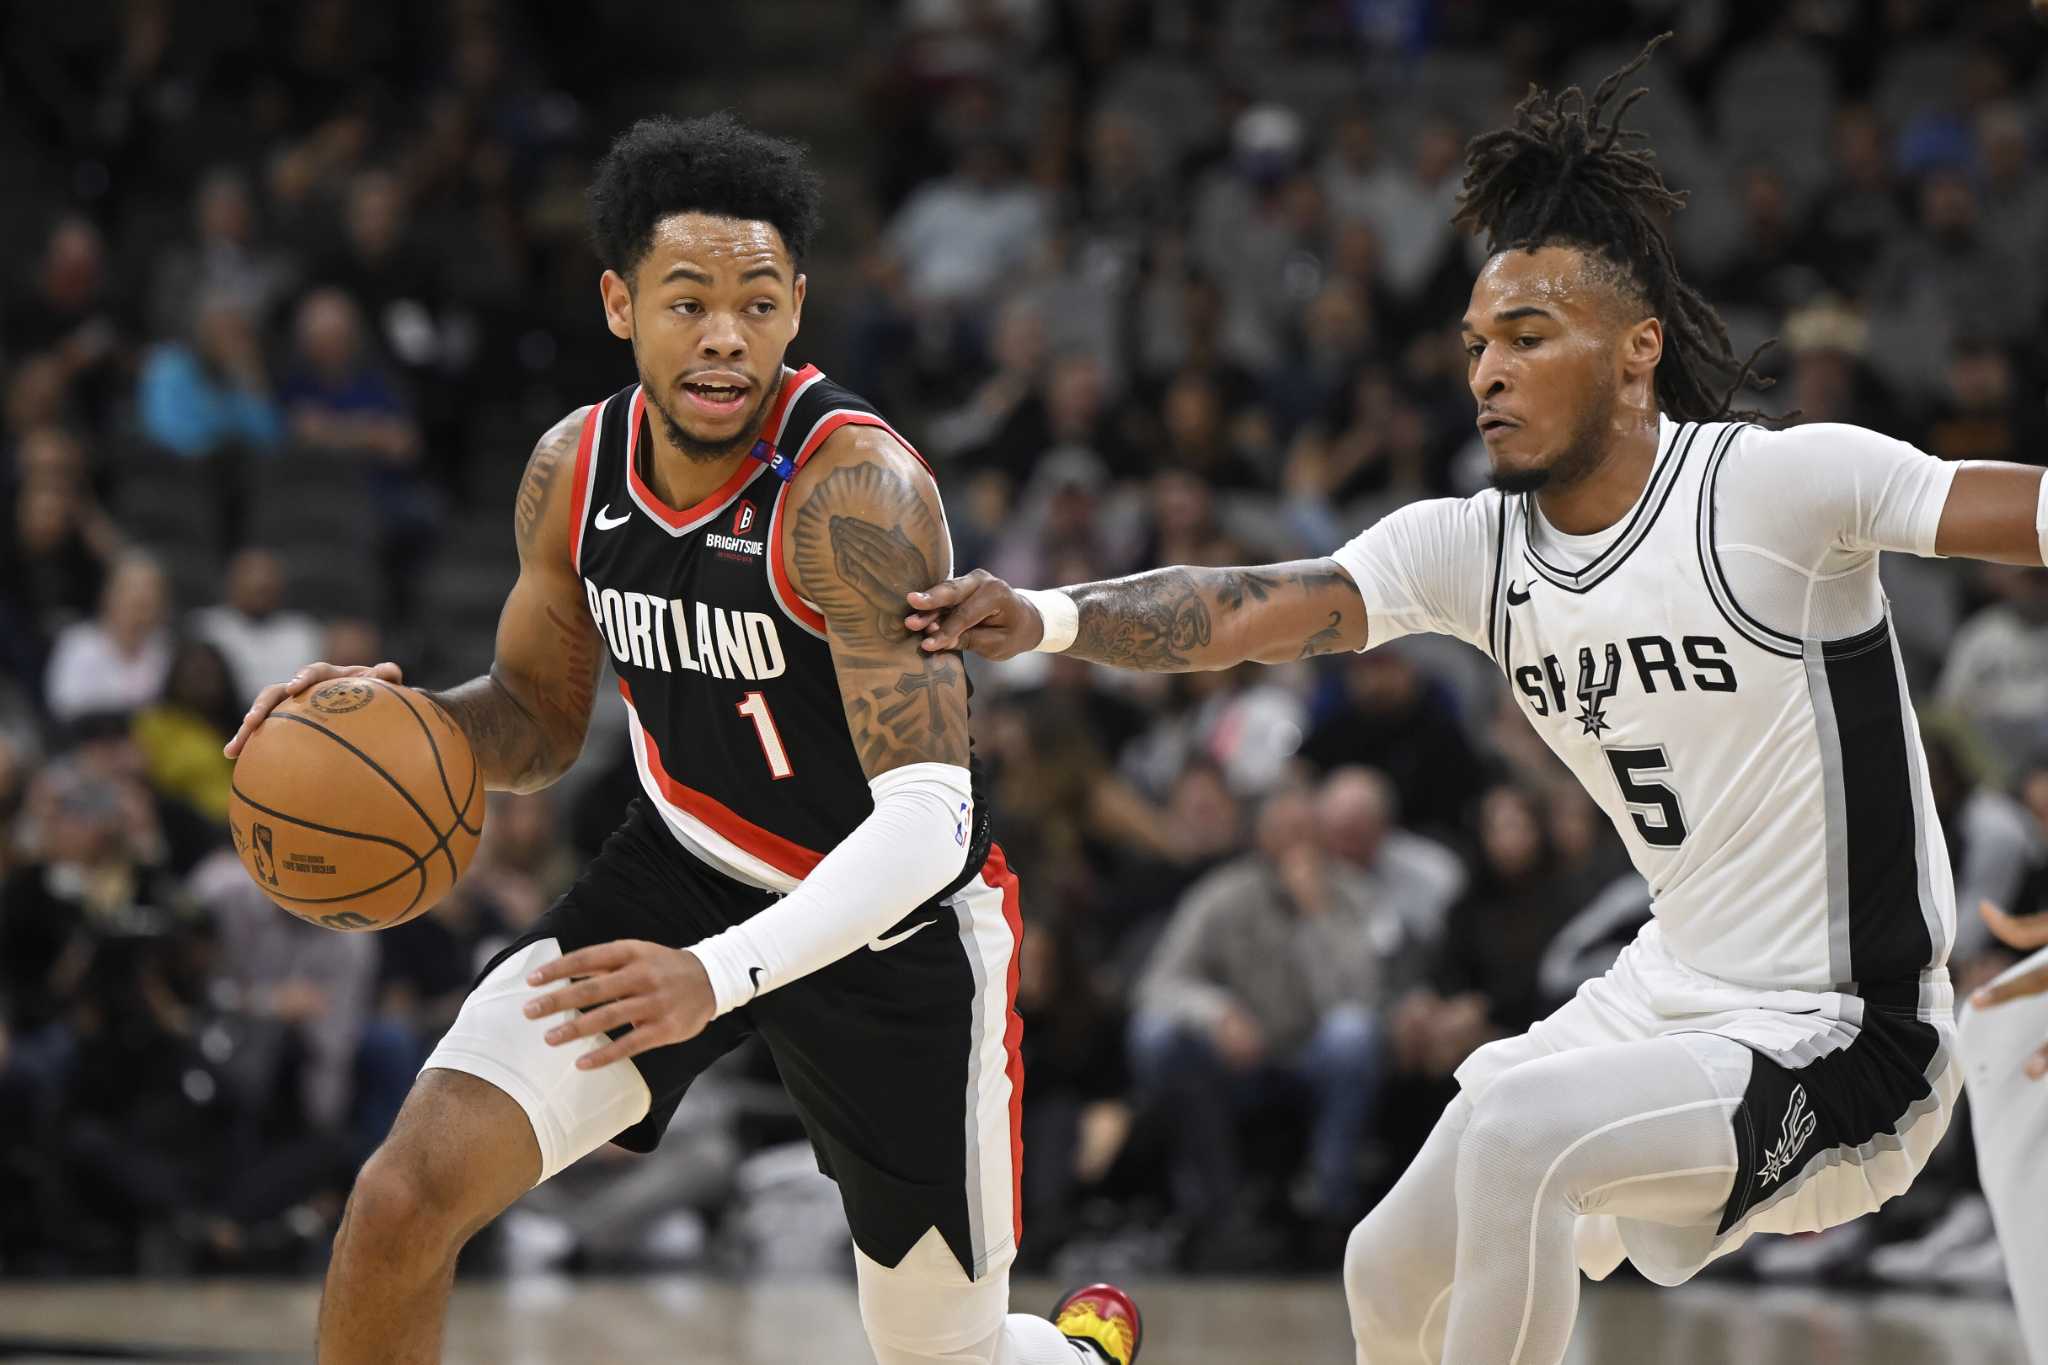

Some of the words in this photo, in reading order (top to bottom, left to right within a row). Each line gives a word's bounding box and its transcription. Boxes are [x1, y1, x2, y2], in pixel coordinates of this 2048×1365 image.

[706, 533, 763, 555] BRIGHTSIDE
[740, 507, 753, 529] B
[584, 577, 787, 681] PORTLAND
[736, 691, 795, 780] 1
[1601, 743, 1690, 850] 5
